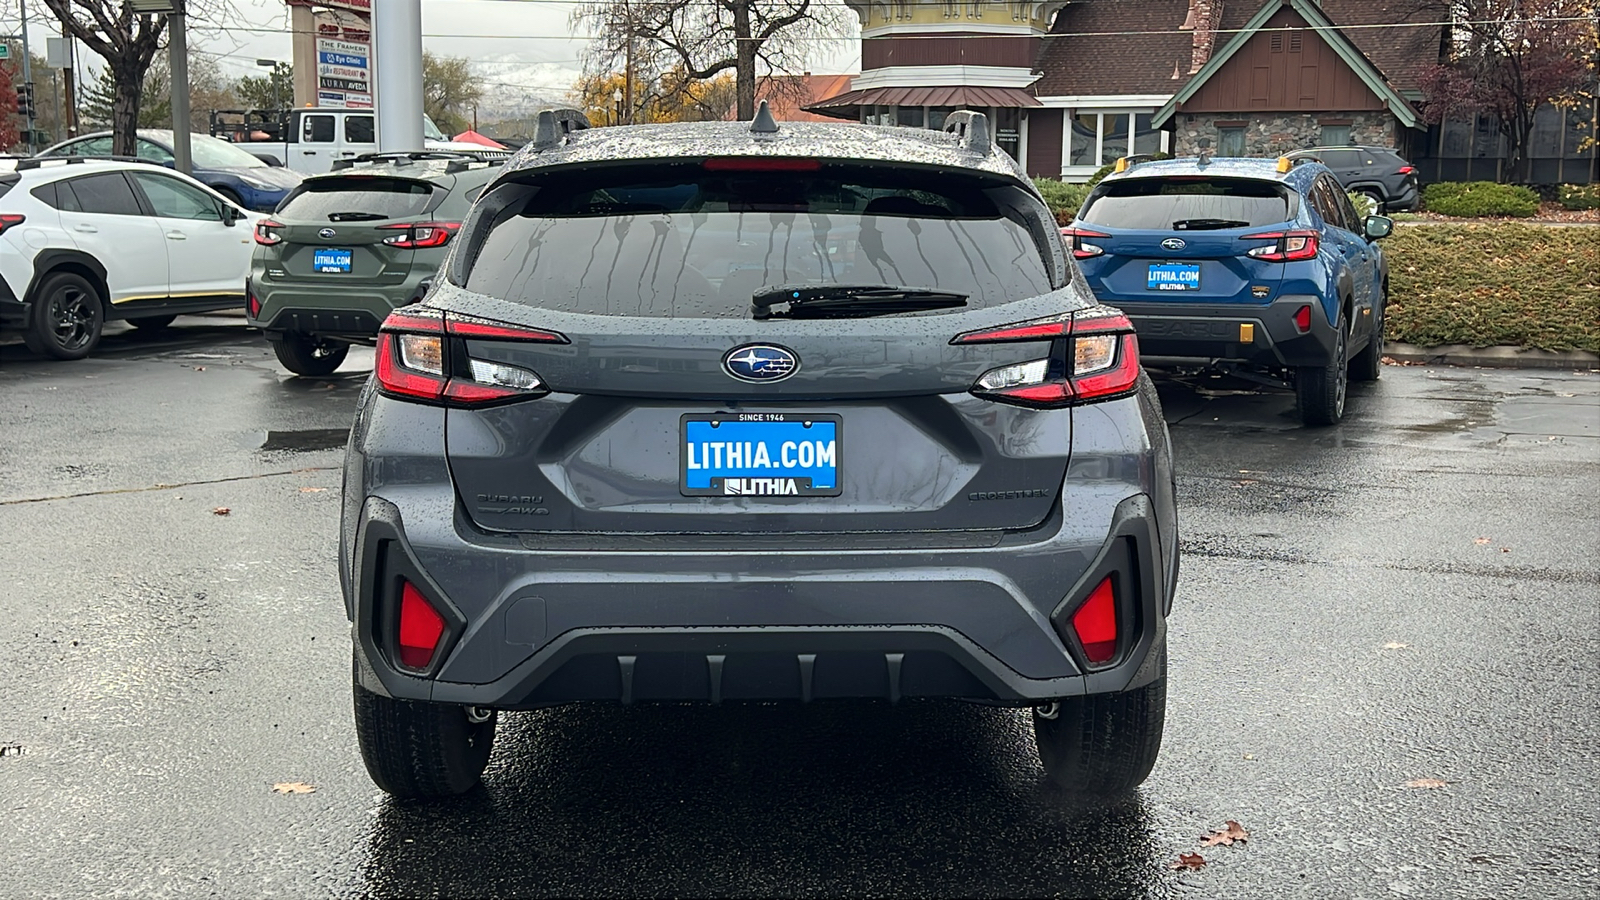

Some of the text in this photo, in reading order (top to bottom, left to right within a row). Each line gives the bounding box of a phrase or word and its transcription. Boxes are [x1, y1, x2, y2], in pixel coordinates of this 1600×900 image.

[337, 42, 366, 51] FRAMERY
[335, 55, 361, 65] Eye Clinic
[321, 79, 366, 91] AURA AVEDA
[314, 255, 351, 265] LITHIA.COM
[1148, 270, 1199, 281] LITHIA.COM
[738, 413, 785, 422] SINCE 1946
[687, 440, 837, 470] LITHIA.COM
[741, 478, 798, 495] LITHIA
[477, 493, 544, 504] SUBARU
[967, 488, 1050, 501] CROSSTREK
[502, 506, 550, 516] AWD
